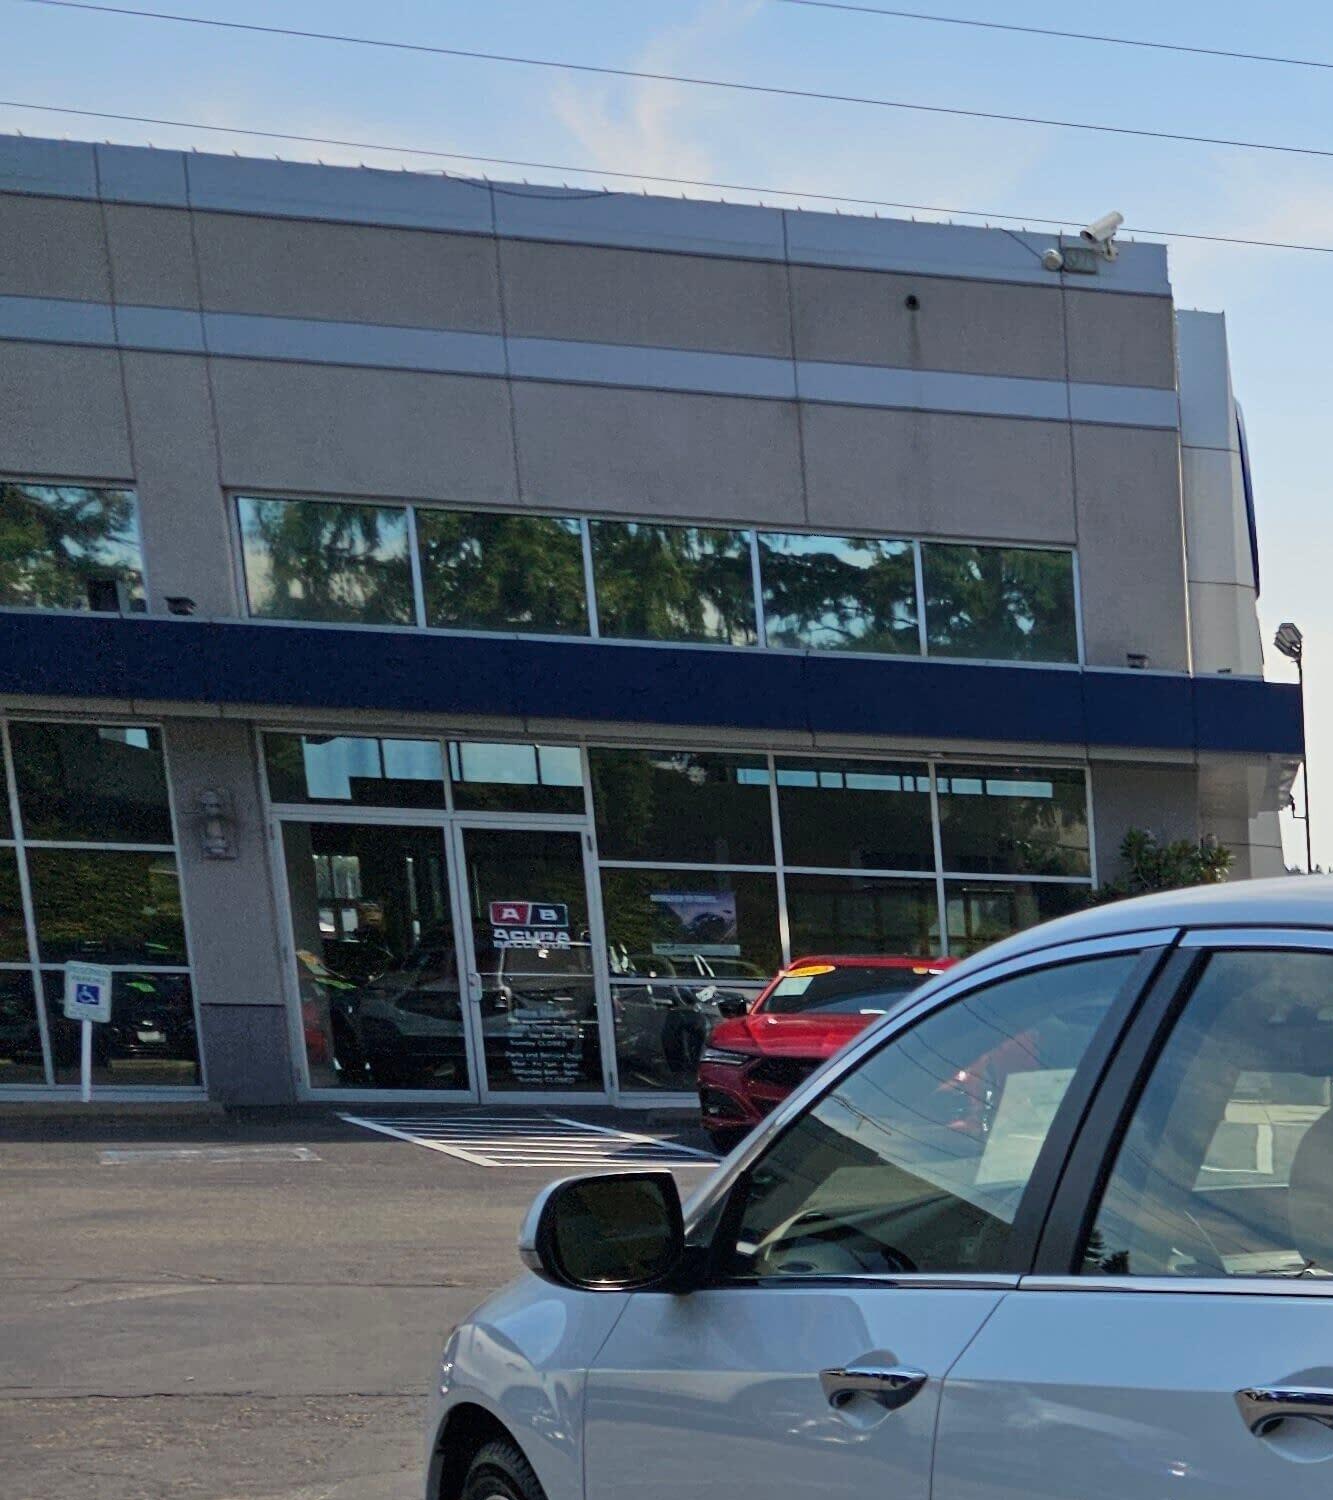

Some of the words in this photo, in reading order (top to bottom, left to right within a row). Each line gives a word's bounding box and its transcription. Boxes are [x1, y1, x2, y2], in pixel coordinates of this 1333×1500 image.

[501, 908, 520, 920] A
[539, 909, 558, 921] B
[493, 929, 570, 941] ACURA
